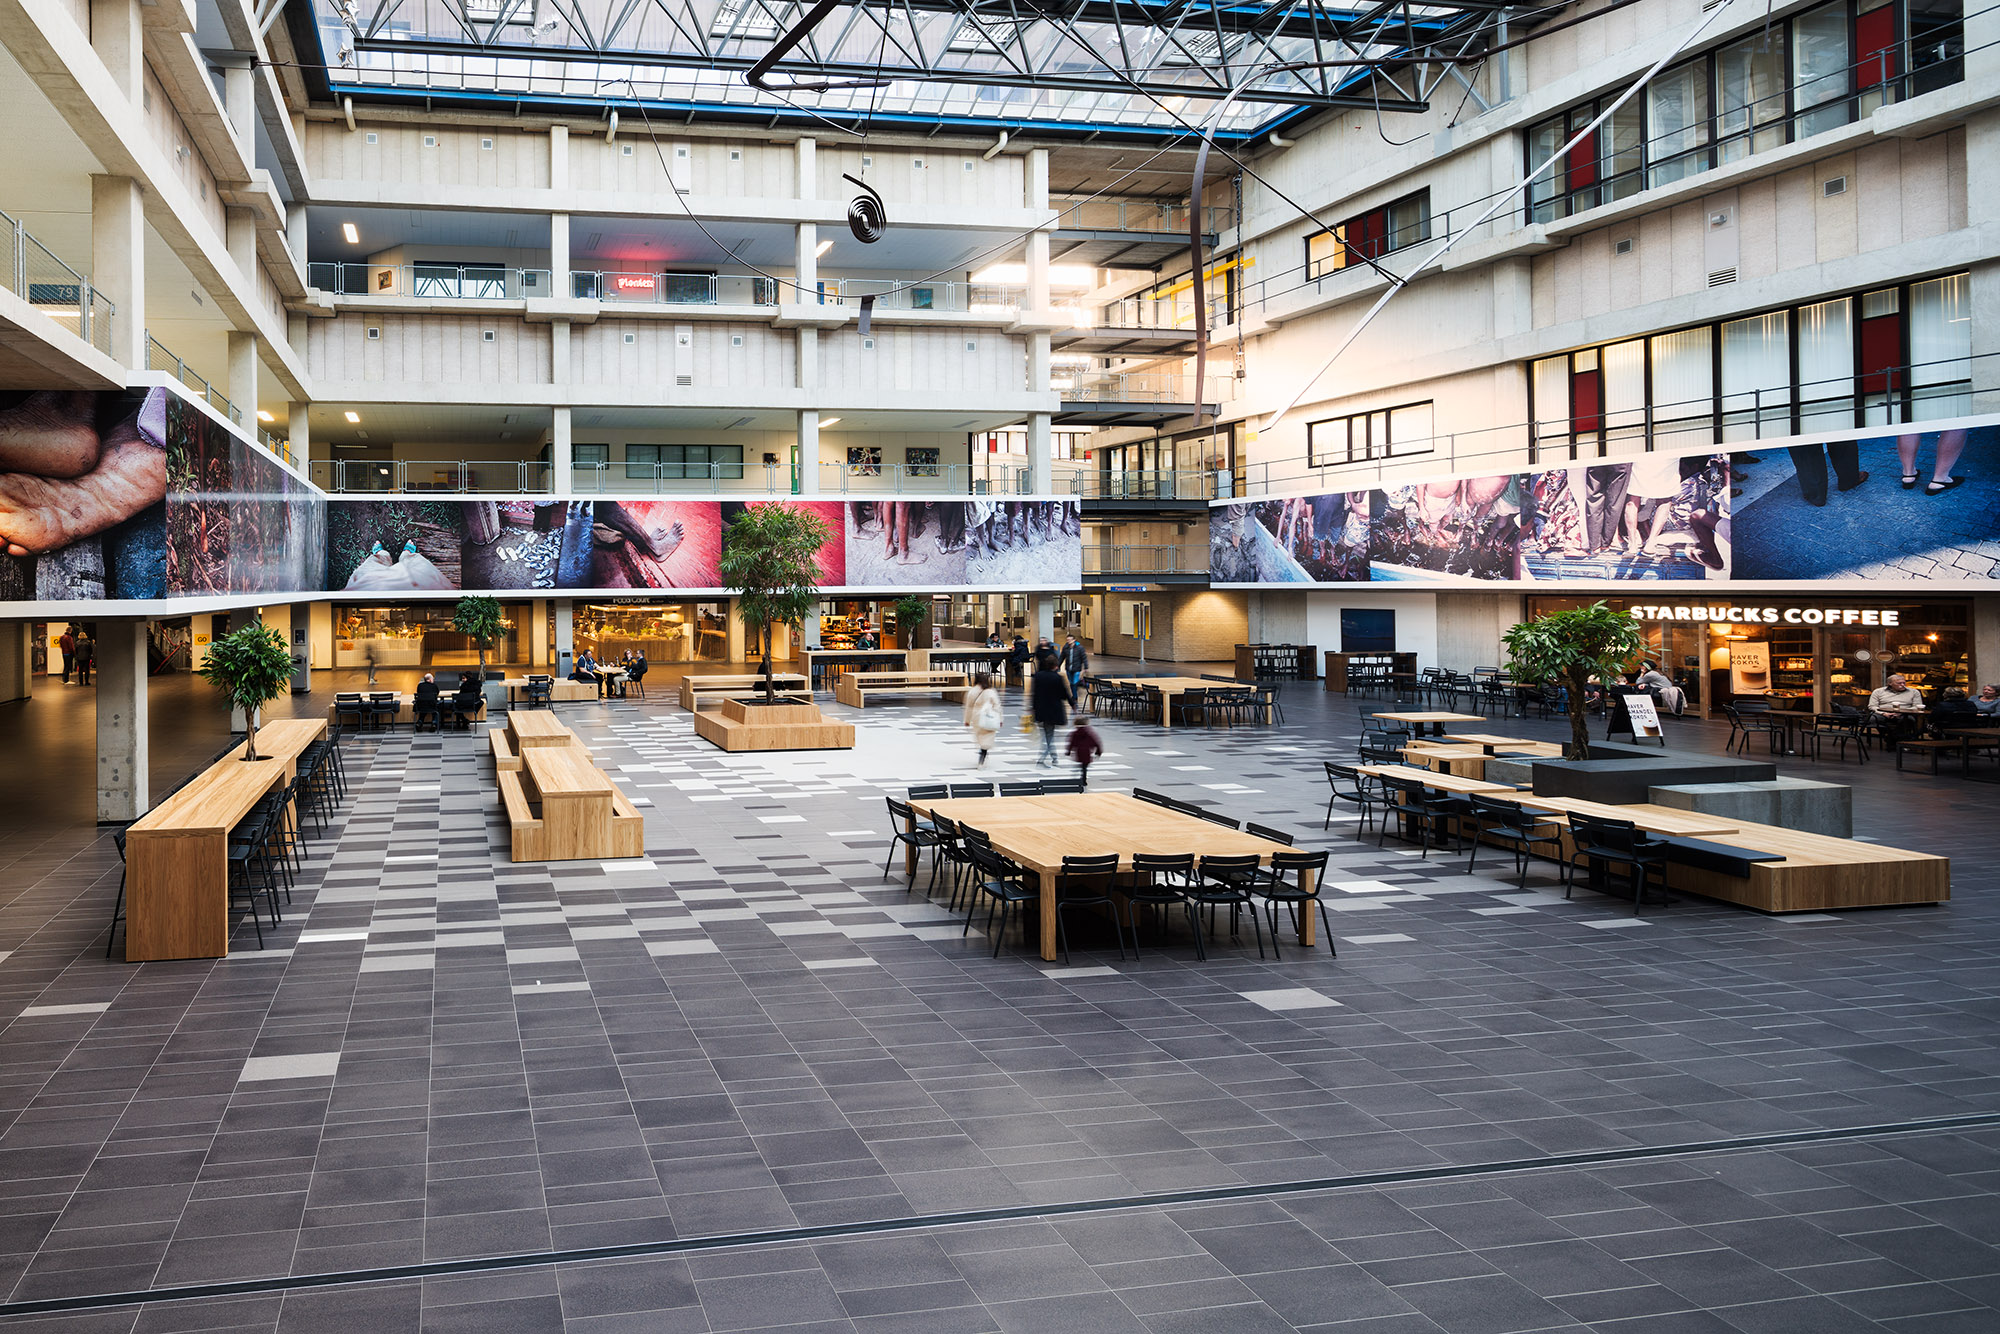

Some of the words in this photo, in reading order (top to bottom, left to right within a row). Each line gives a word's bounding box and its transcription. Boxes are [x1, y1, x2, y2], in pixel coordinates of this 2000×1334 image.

[58, 287, 73, 298] 79
[1630, 605, 1779, 623] STARBUCKS
[1783, 608, 1900, 626] COFFEE
